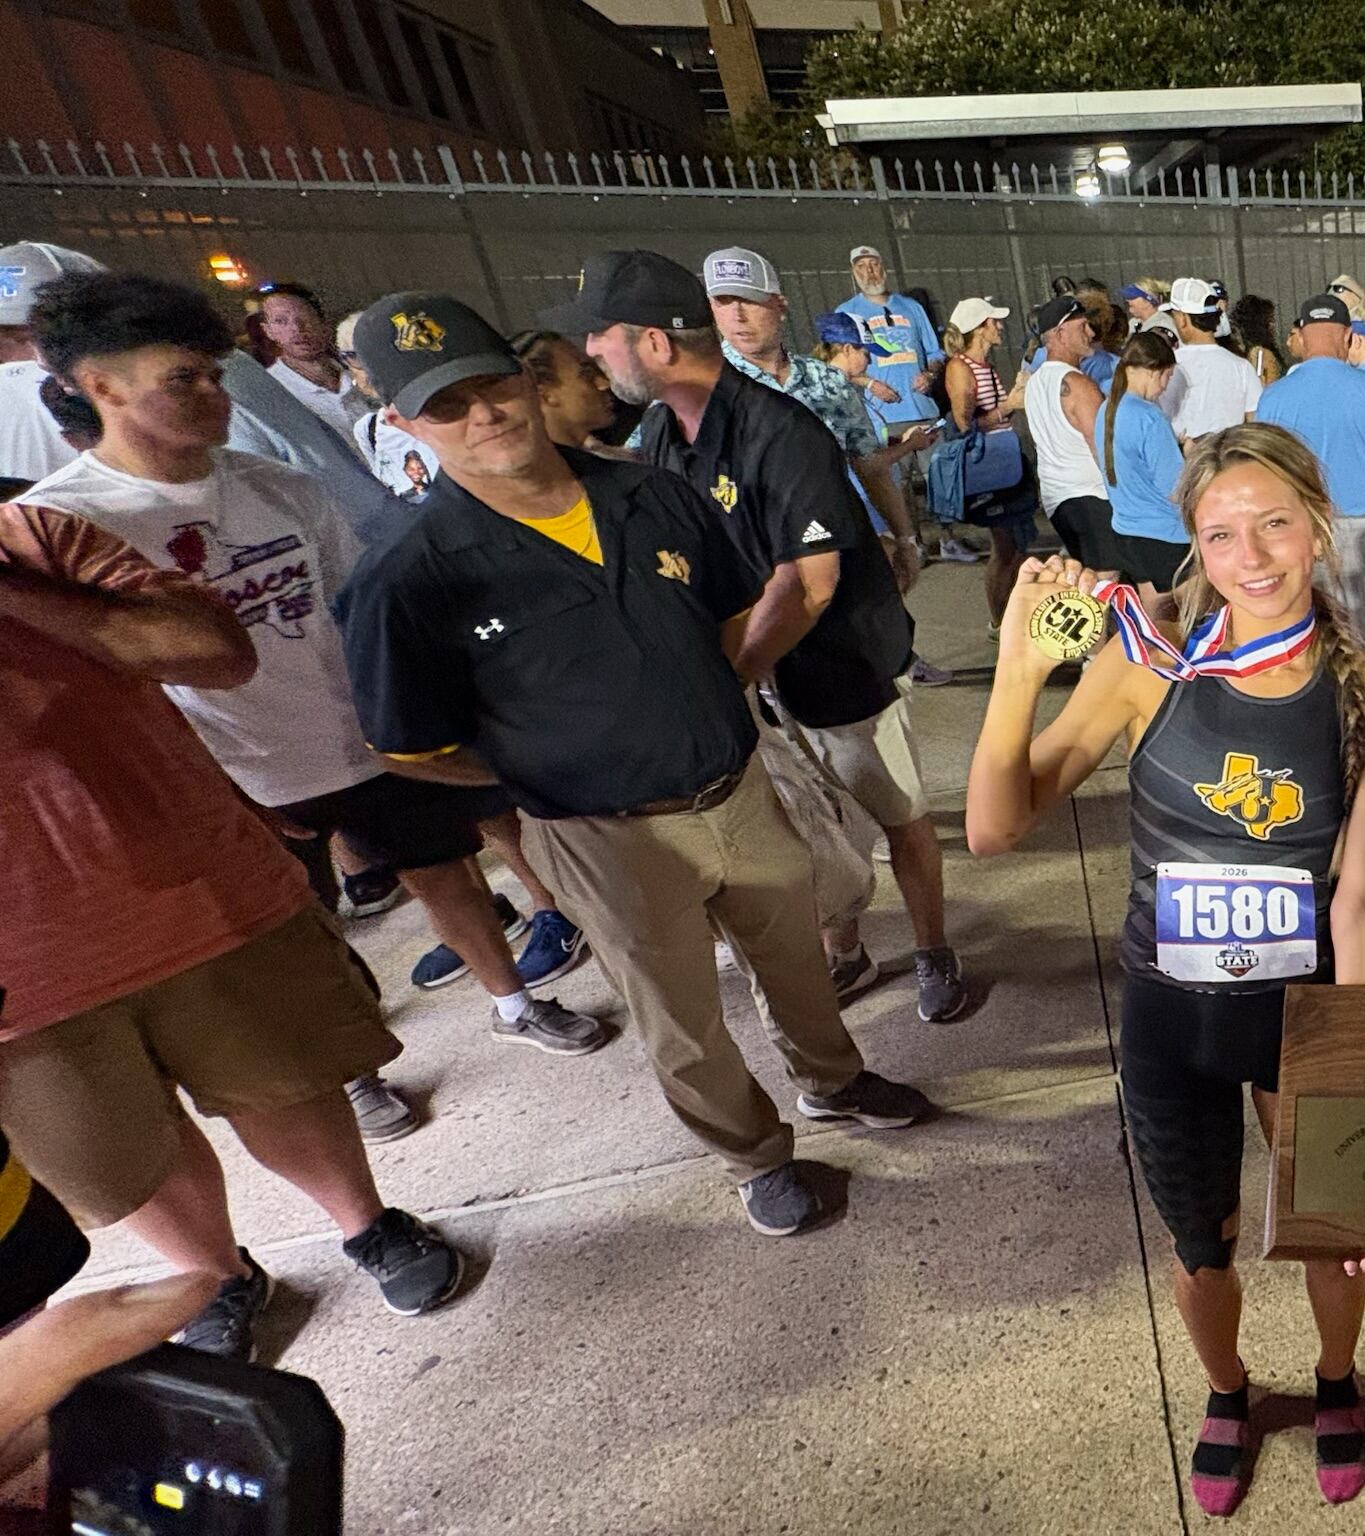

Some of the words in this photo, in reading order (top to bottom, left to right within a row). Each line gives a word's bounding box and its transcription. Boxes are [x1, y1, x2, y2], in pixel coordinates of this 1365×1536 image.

[1044, 627, 1069, 646] STATE
[1221, 868, 1248, 876] 2026
[1171, 885, 1299, 939] 1580
[1216, 955, 1258, 966] STATE
